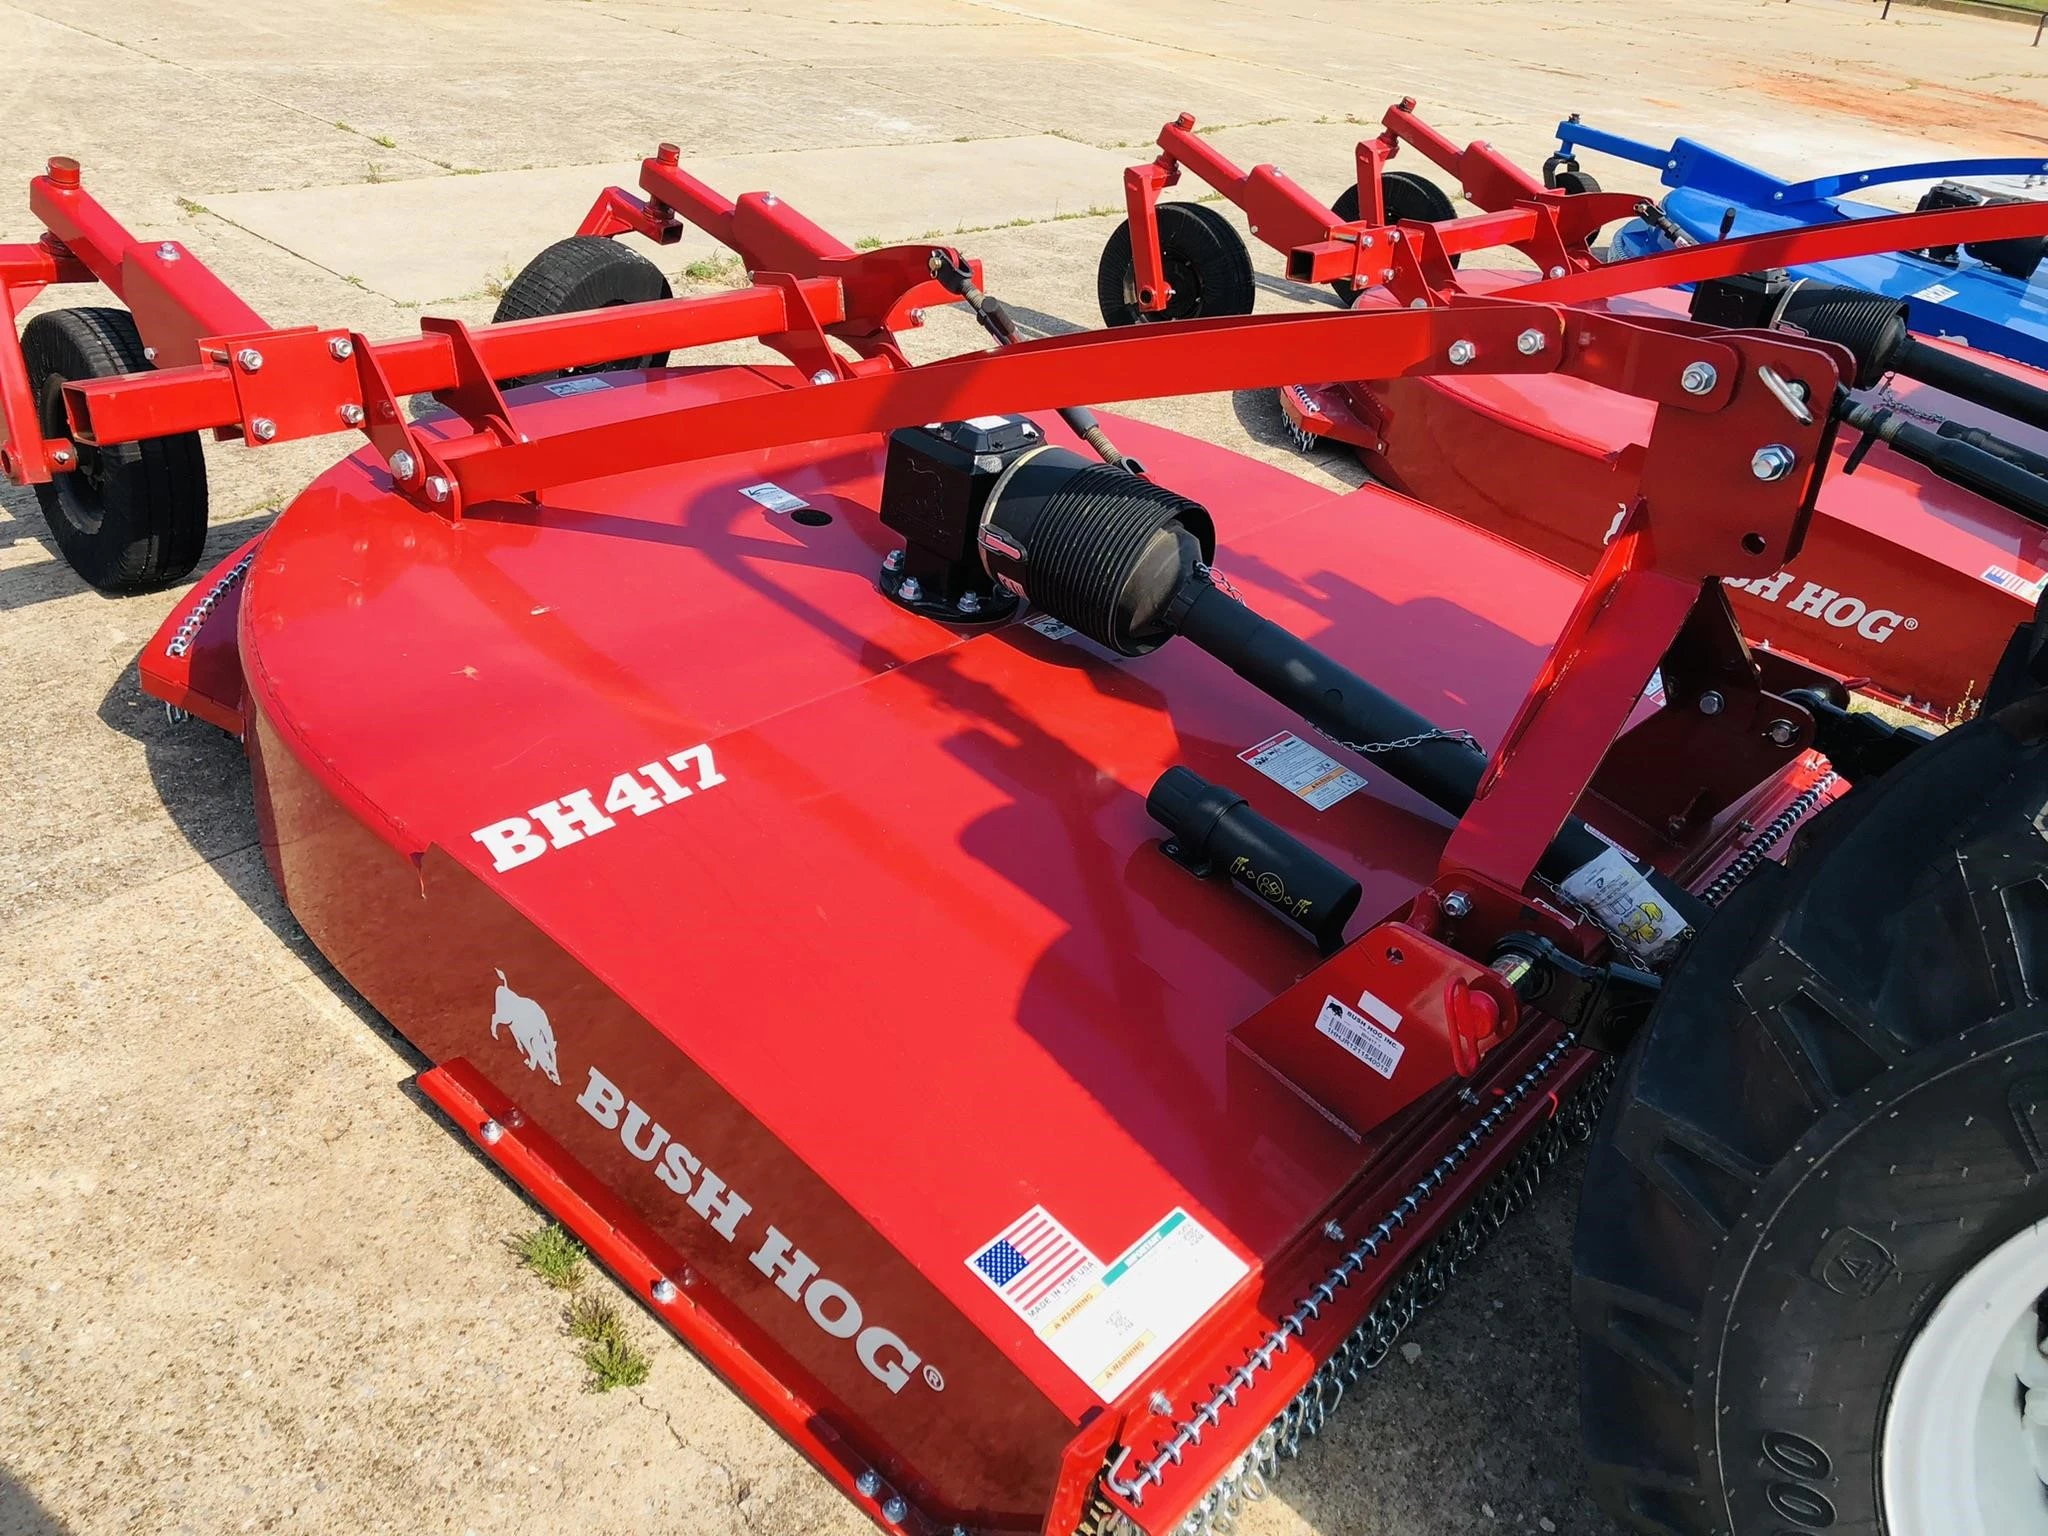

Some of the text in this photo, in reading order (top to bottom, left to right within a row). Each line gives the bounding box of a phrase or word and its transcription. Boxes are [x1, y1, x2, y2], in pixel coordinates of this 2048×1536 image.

[470, 743, 727, 873] BH417
[575, 1066, 753, 1242] BUSH
[1028, 1261, 1095, 1317] MADE IN THE USA
[1060, 1293, 1094, 1322] WARNING
[1112, 1341, 1145, 1371] WARNING
